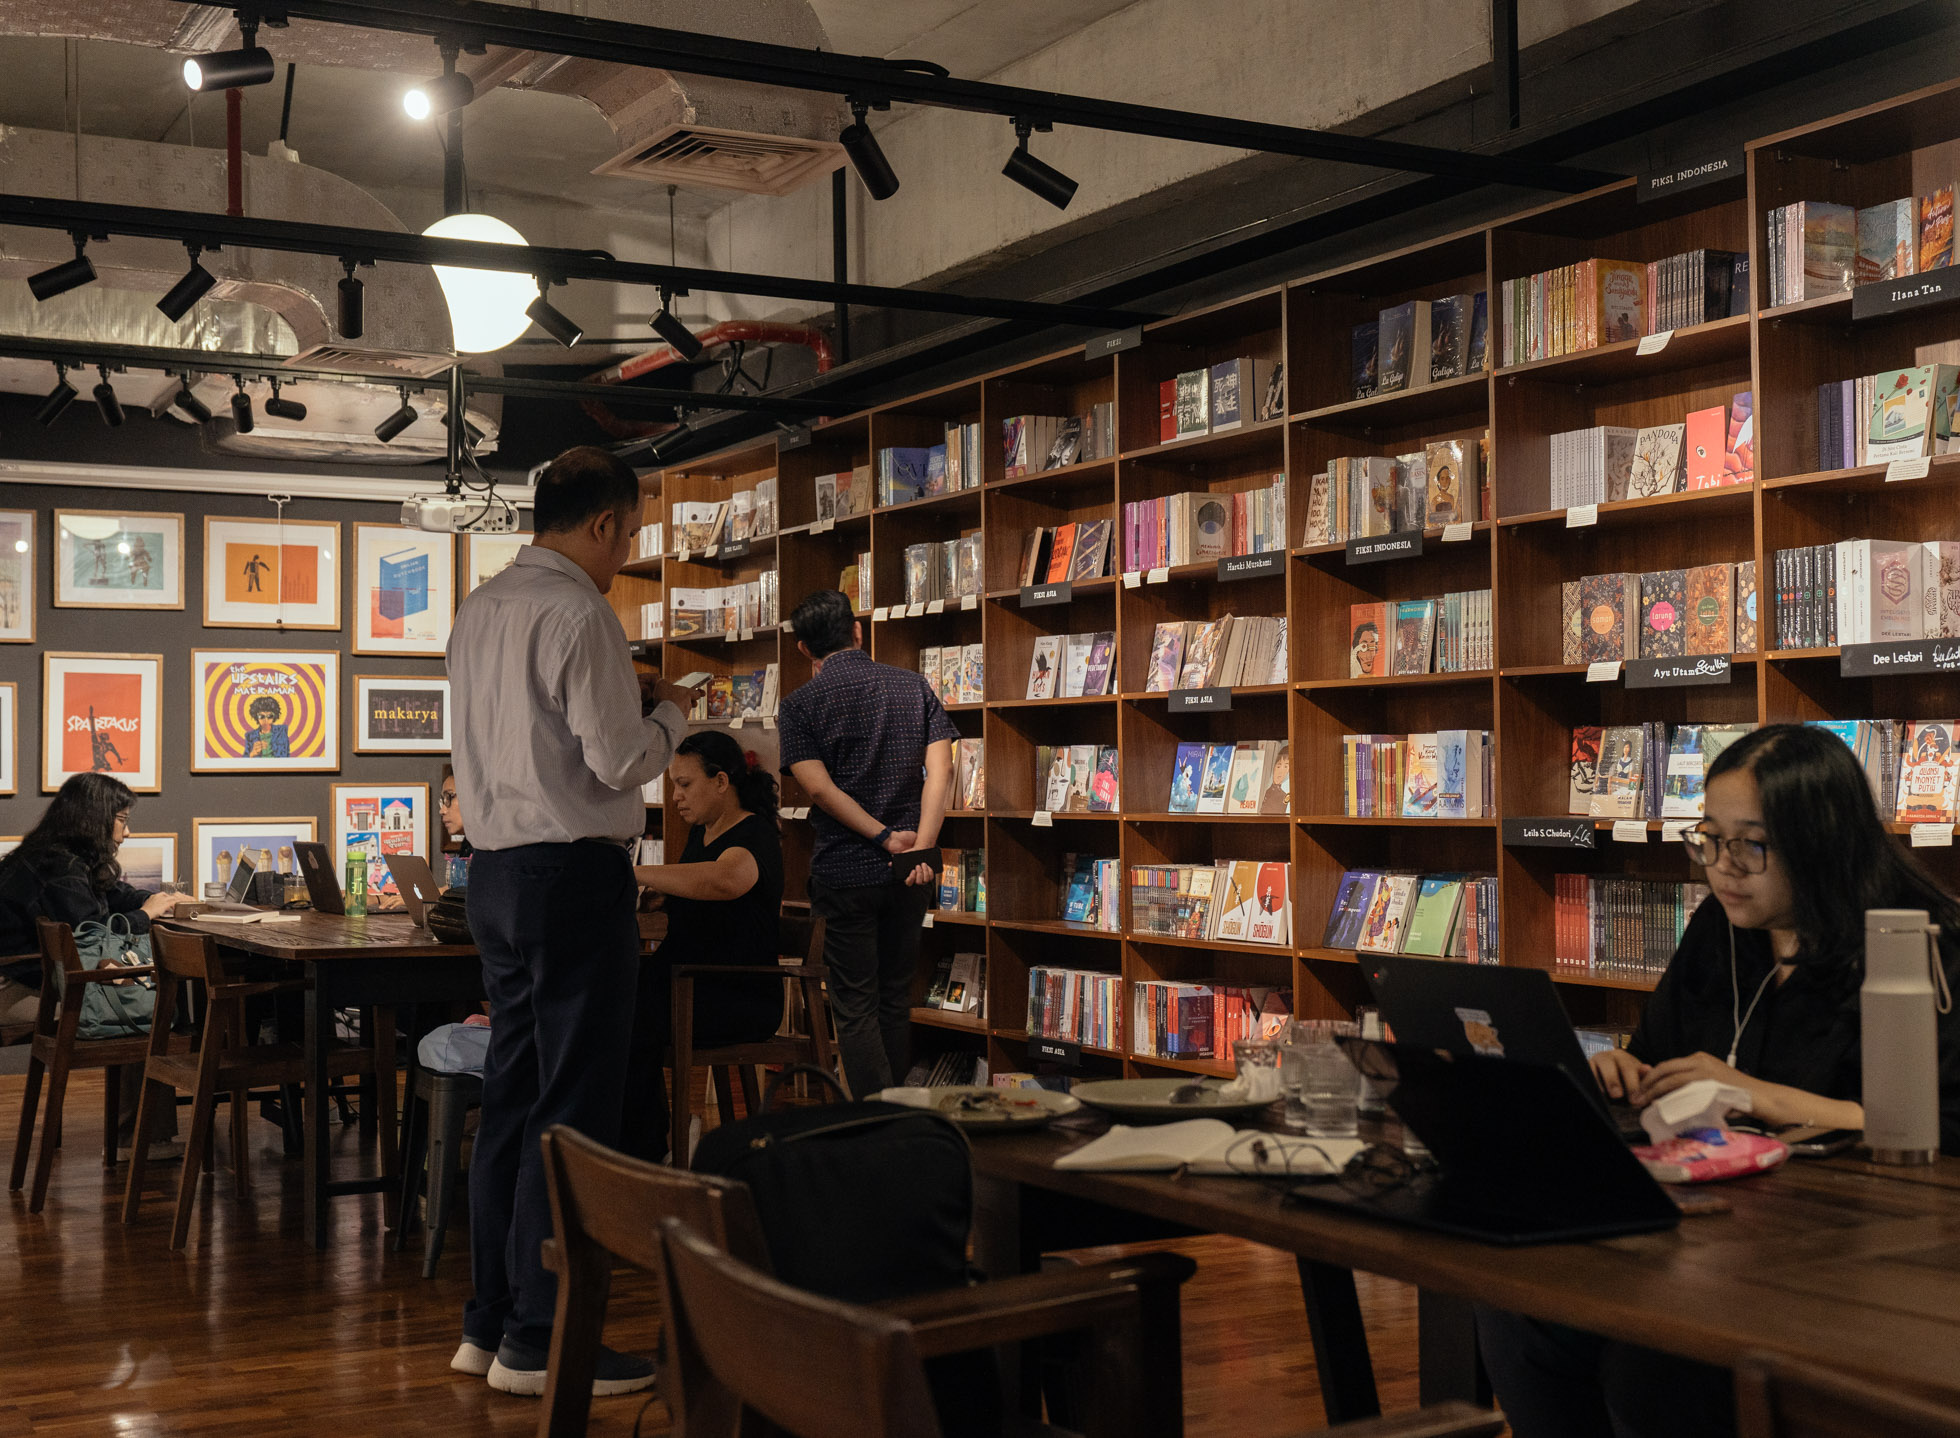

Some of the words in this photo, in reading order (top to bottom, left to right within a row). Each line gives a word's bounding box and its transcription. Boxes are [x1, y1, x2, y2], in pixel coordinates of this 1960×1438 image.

[1651, 175, 1674, 189] FIKSI
[1677, 160, 1729, 182] INDONESIA
[1891, 289, 1920, 302] Ilana
[1921, 284, 1942, 295] Tan
[1366, 387, 1379, 398] Gal
[1639, 429, 1679, 446] PANDORA
[1355, 546, 1372, 555] FIKSI
[1374, 540, 1412, 553] INDONESIA
[1246, 558, 1272, 570] Murakami
[1652, 612, 1673, 622] larung
[1873, 654, 1891, 665] Dee
[1893, 651, 1923, 664] Lestari
[1653, 668, 1671, 679] Ayu
[1185, 696, 1199, 705] FIKSI
[1200, 695, 1213, 704] ASIA
[374, 706, 438, 723] makarya
[67, 715, 139, 732] SPARTACUS
[1915, 776, 1941, 785] MONYET
[1918, 784, 1936, 792] PUTIH
[1523, 828, 1539, 838] Leila
[1540, 828, 1546, 838] S.
[1546, 828, 1571, 839] Chudori
